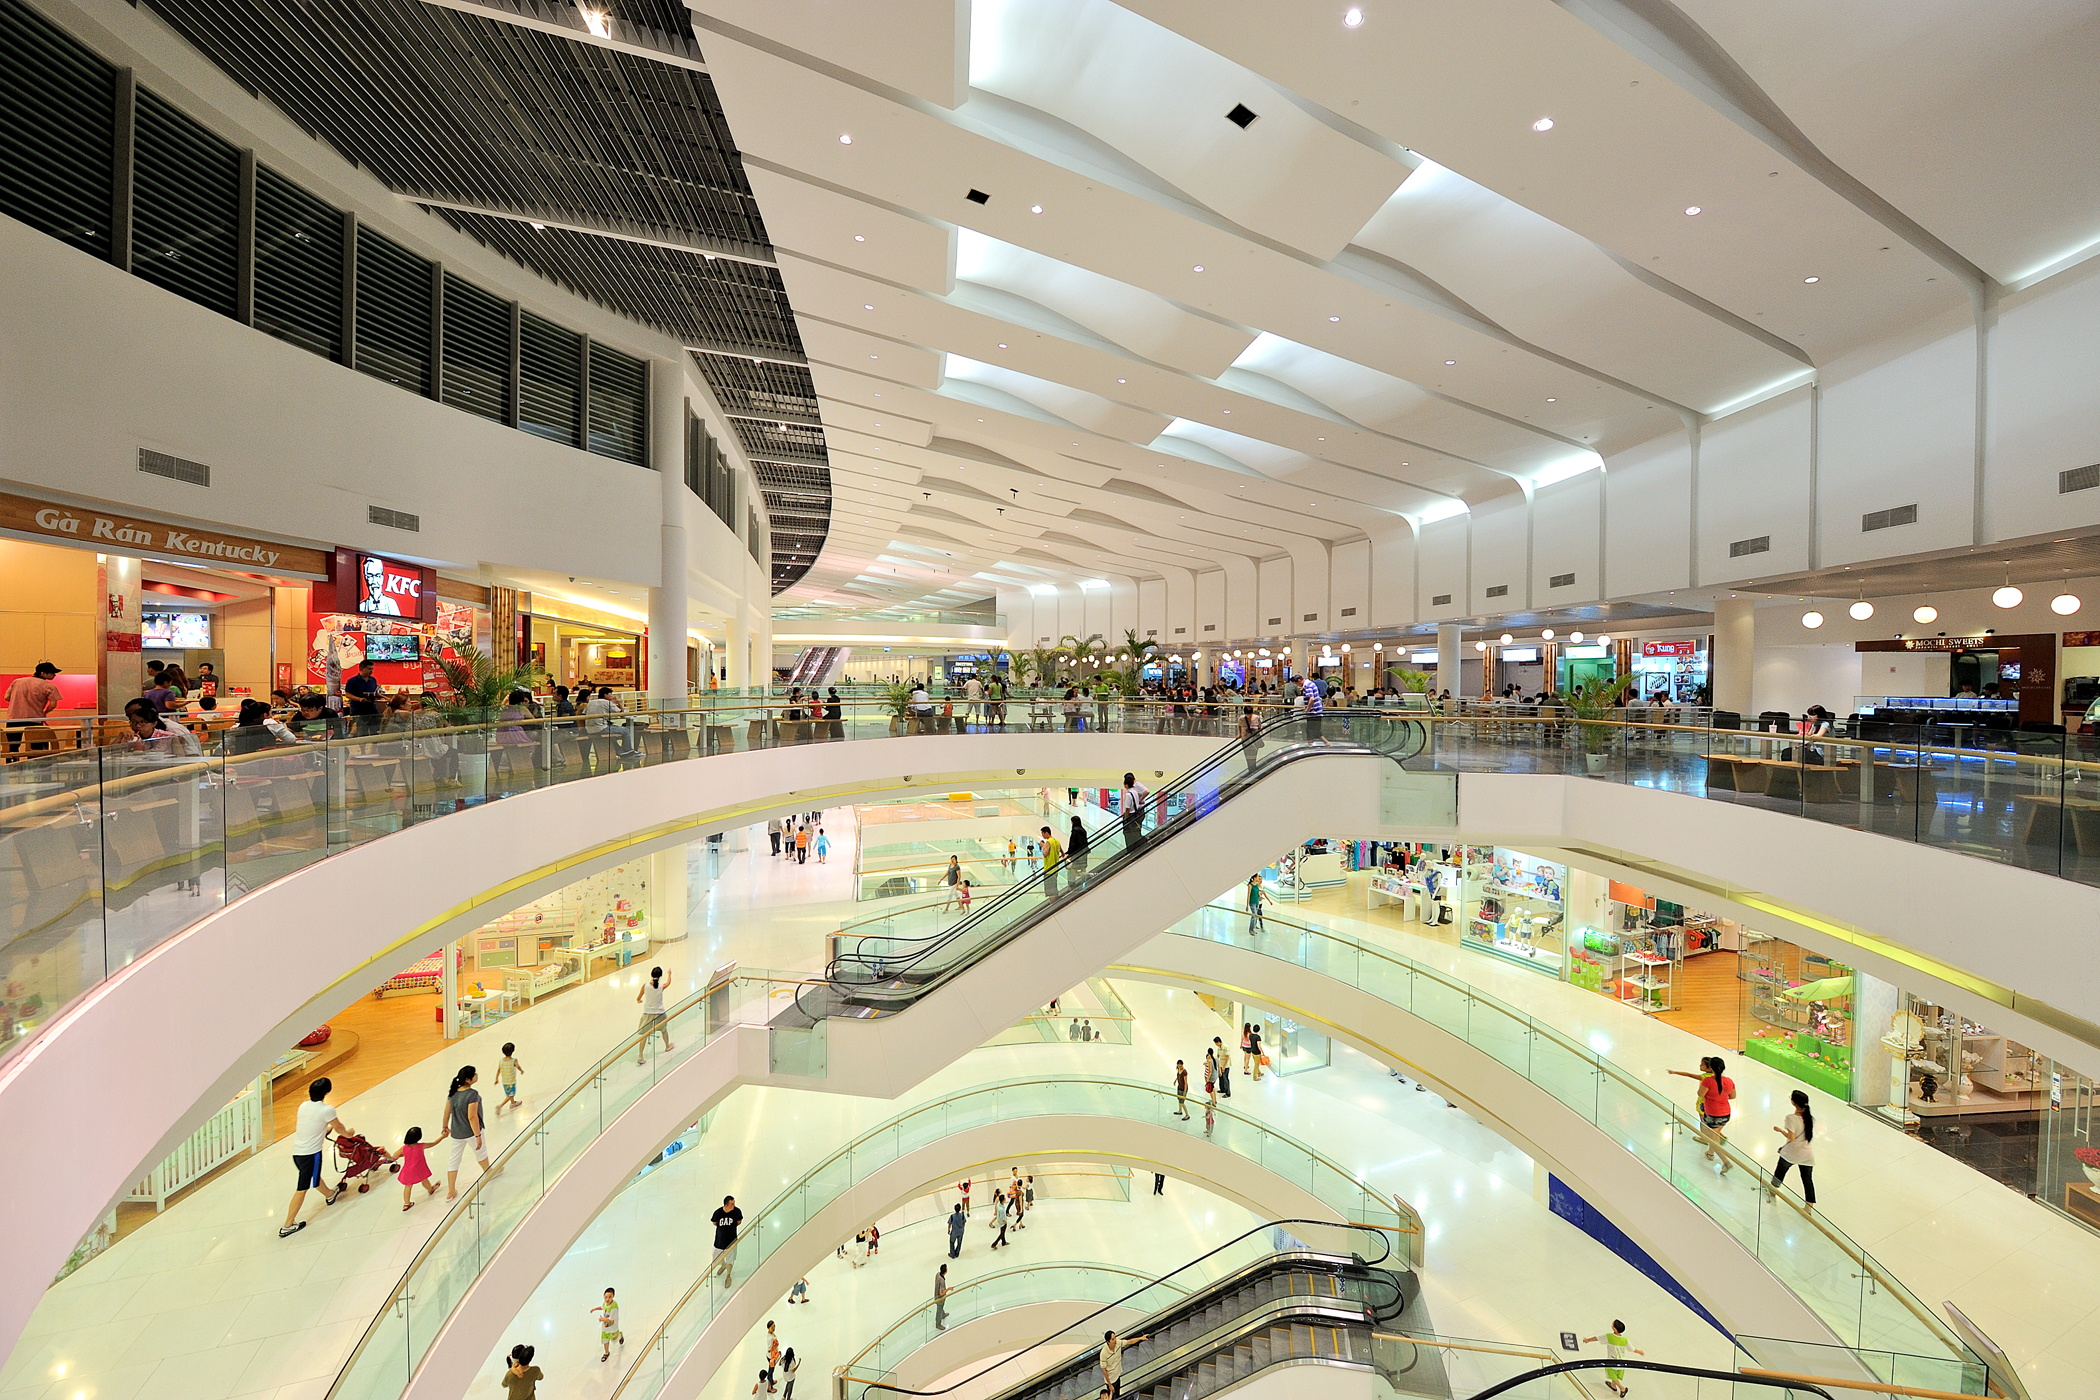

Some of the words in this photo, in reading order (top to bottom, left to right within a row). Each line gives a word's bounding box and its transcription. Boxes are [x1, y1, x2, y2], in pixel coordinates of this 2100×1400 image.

[34, 508, 81, 534] Gà
[92, 517, 152, 546] Rán
[164, 531, 281, 567] Kentucky
[385, 573, 422, 598] KFC
[1948, 637, 1984, 645] SWEETS
[719, 1217, 733, 1226] GAP
